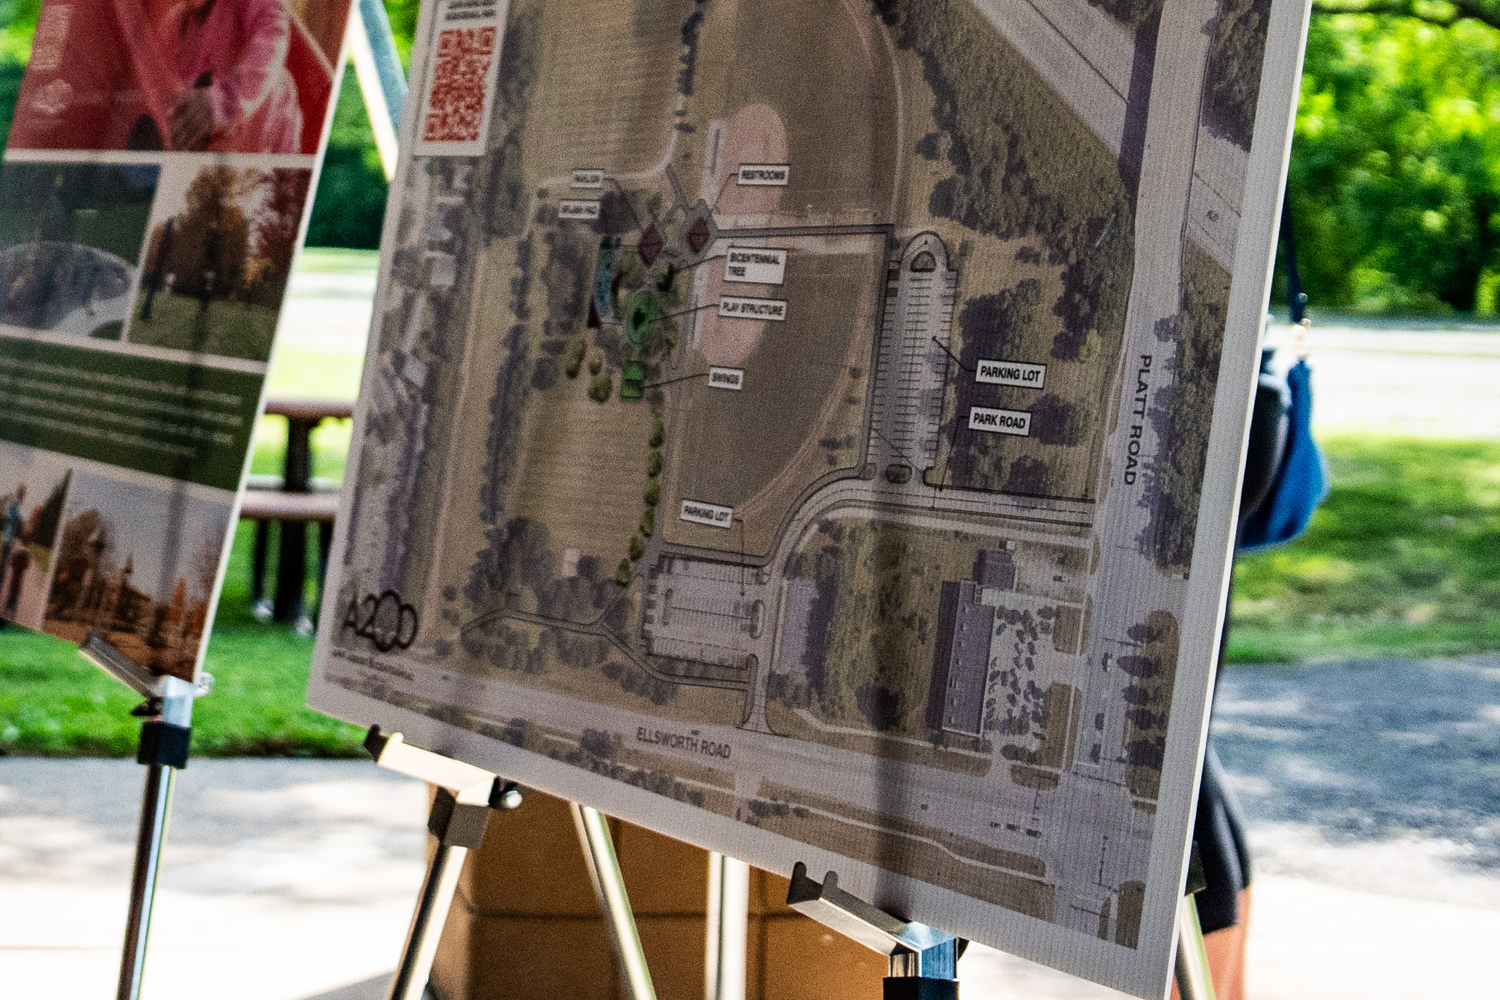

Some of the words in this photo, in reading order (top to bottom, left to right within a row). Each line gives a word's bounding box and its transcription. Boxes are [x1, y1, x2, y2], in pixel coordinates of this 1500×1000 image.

[980, 365, 1020, 380] PARKING
[1021, 369, 1041, 382] LOT
[1132, 354, 1153, 420] PLATT
[973, 412, 999, 427] PARK
[999, 415, 1026, 429] ROAD
[1124, 424, 1143, 486] ROAD
[636, 726, 699, 753] ELLSWORTH
[700, 739, 732, 759] ROAD
